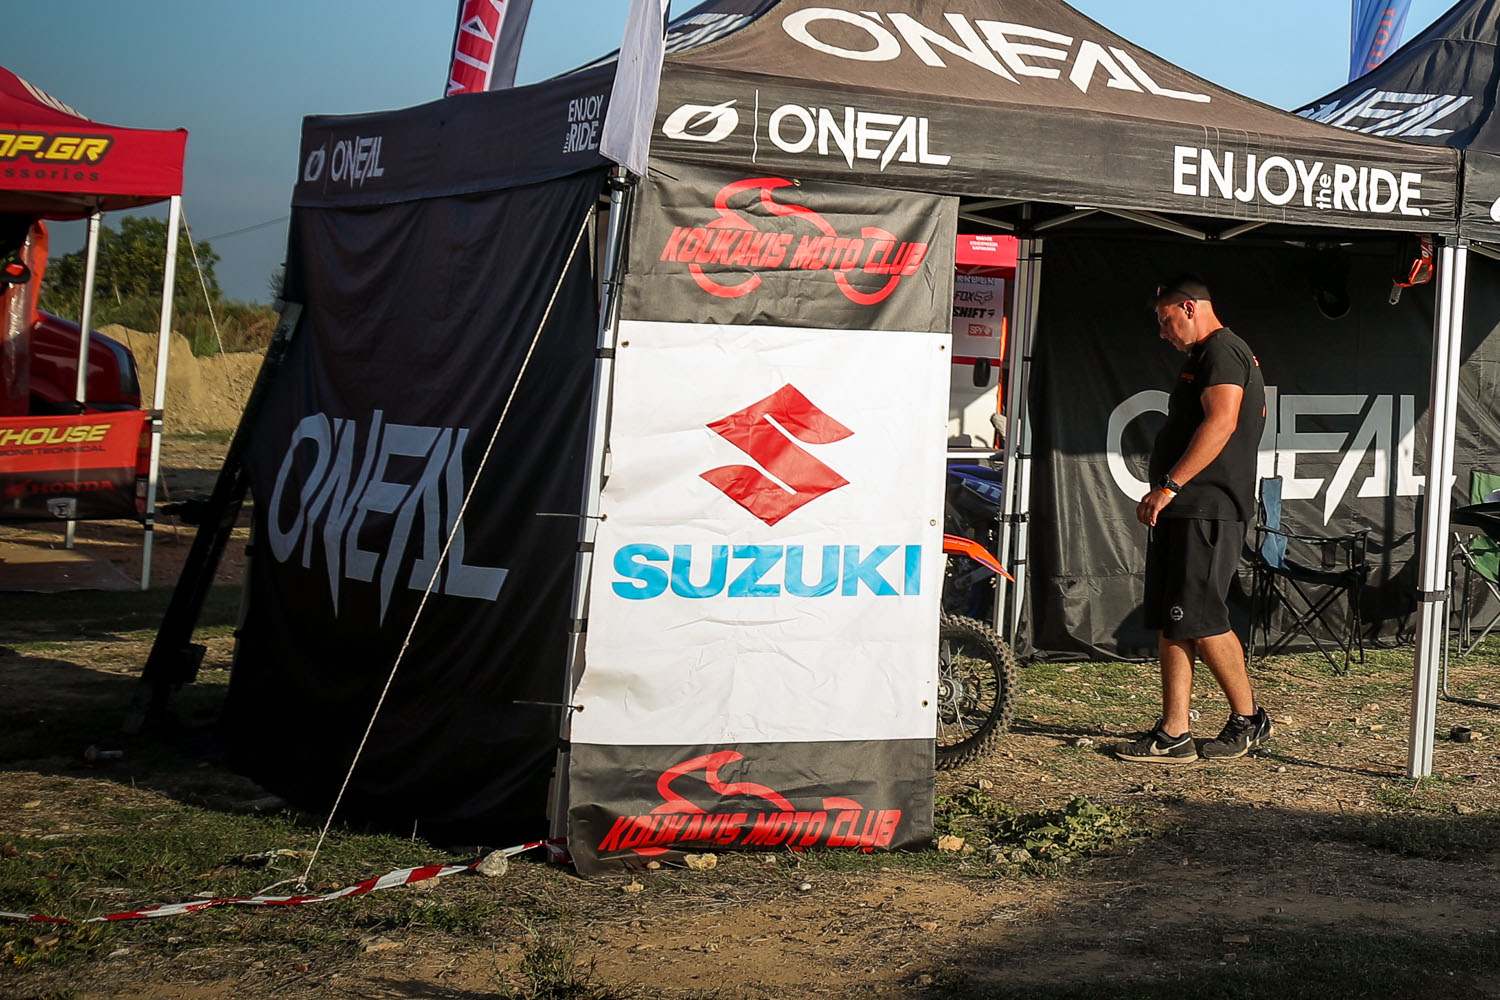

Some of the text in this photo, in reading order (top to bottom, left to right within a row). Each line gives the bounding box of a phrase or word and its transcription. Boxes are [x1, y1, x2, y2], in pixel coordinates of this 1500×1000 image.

[568, 95, 604, 122] ENJOY
[1173, 145, 1324, 206] ENJOY
[1315, 173, 1332, 210] the
[659, 226, 930, 276] KOUKAKIS MOTO CLUB
[612, 543, 921, 600] SUZUKI
[597, 809, 902, 851] KOUKAKIS MOTO CLUB
